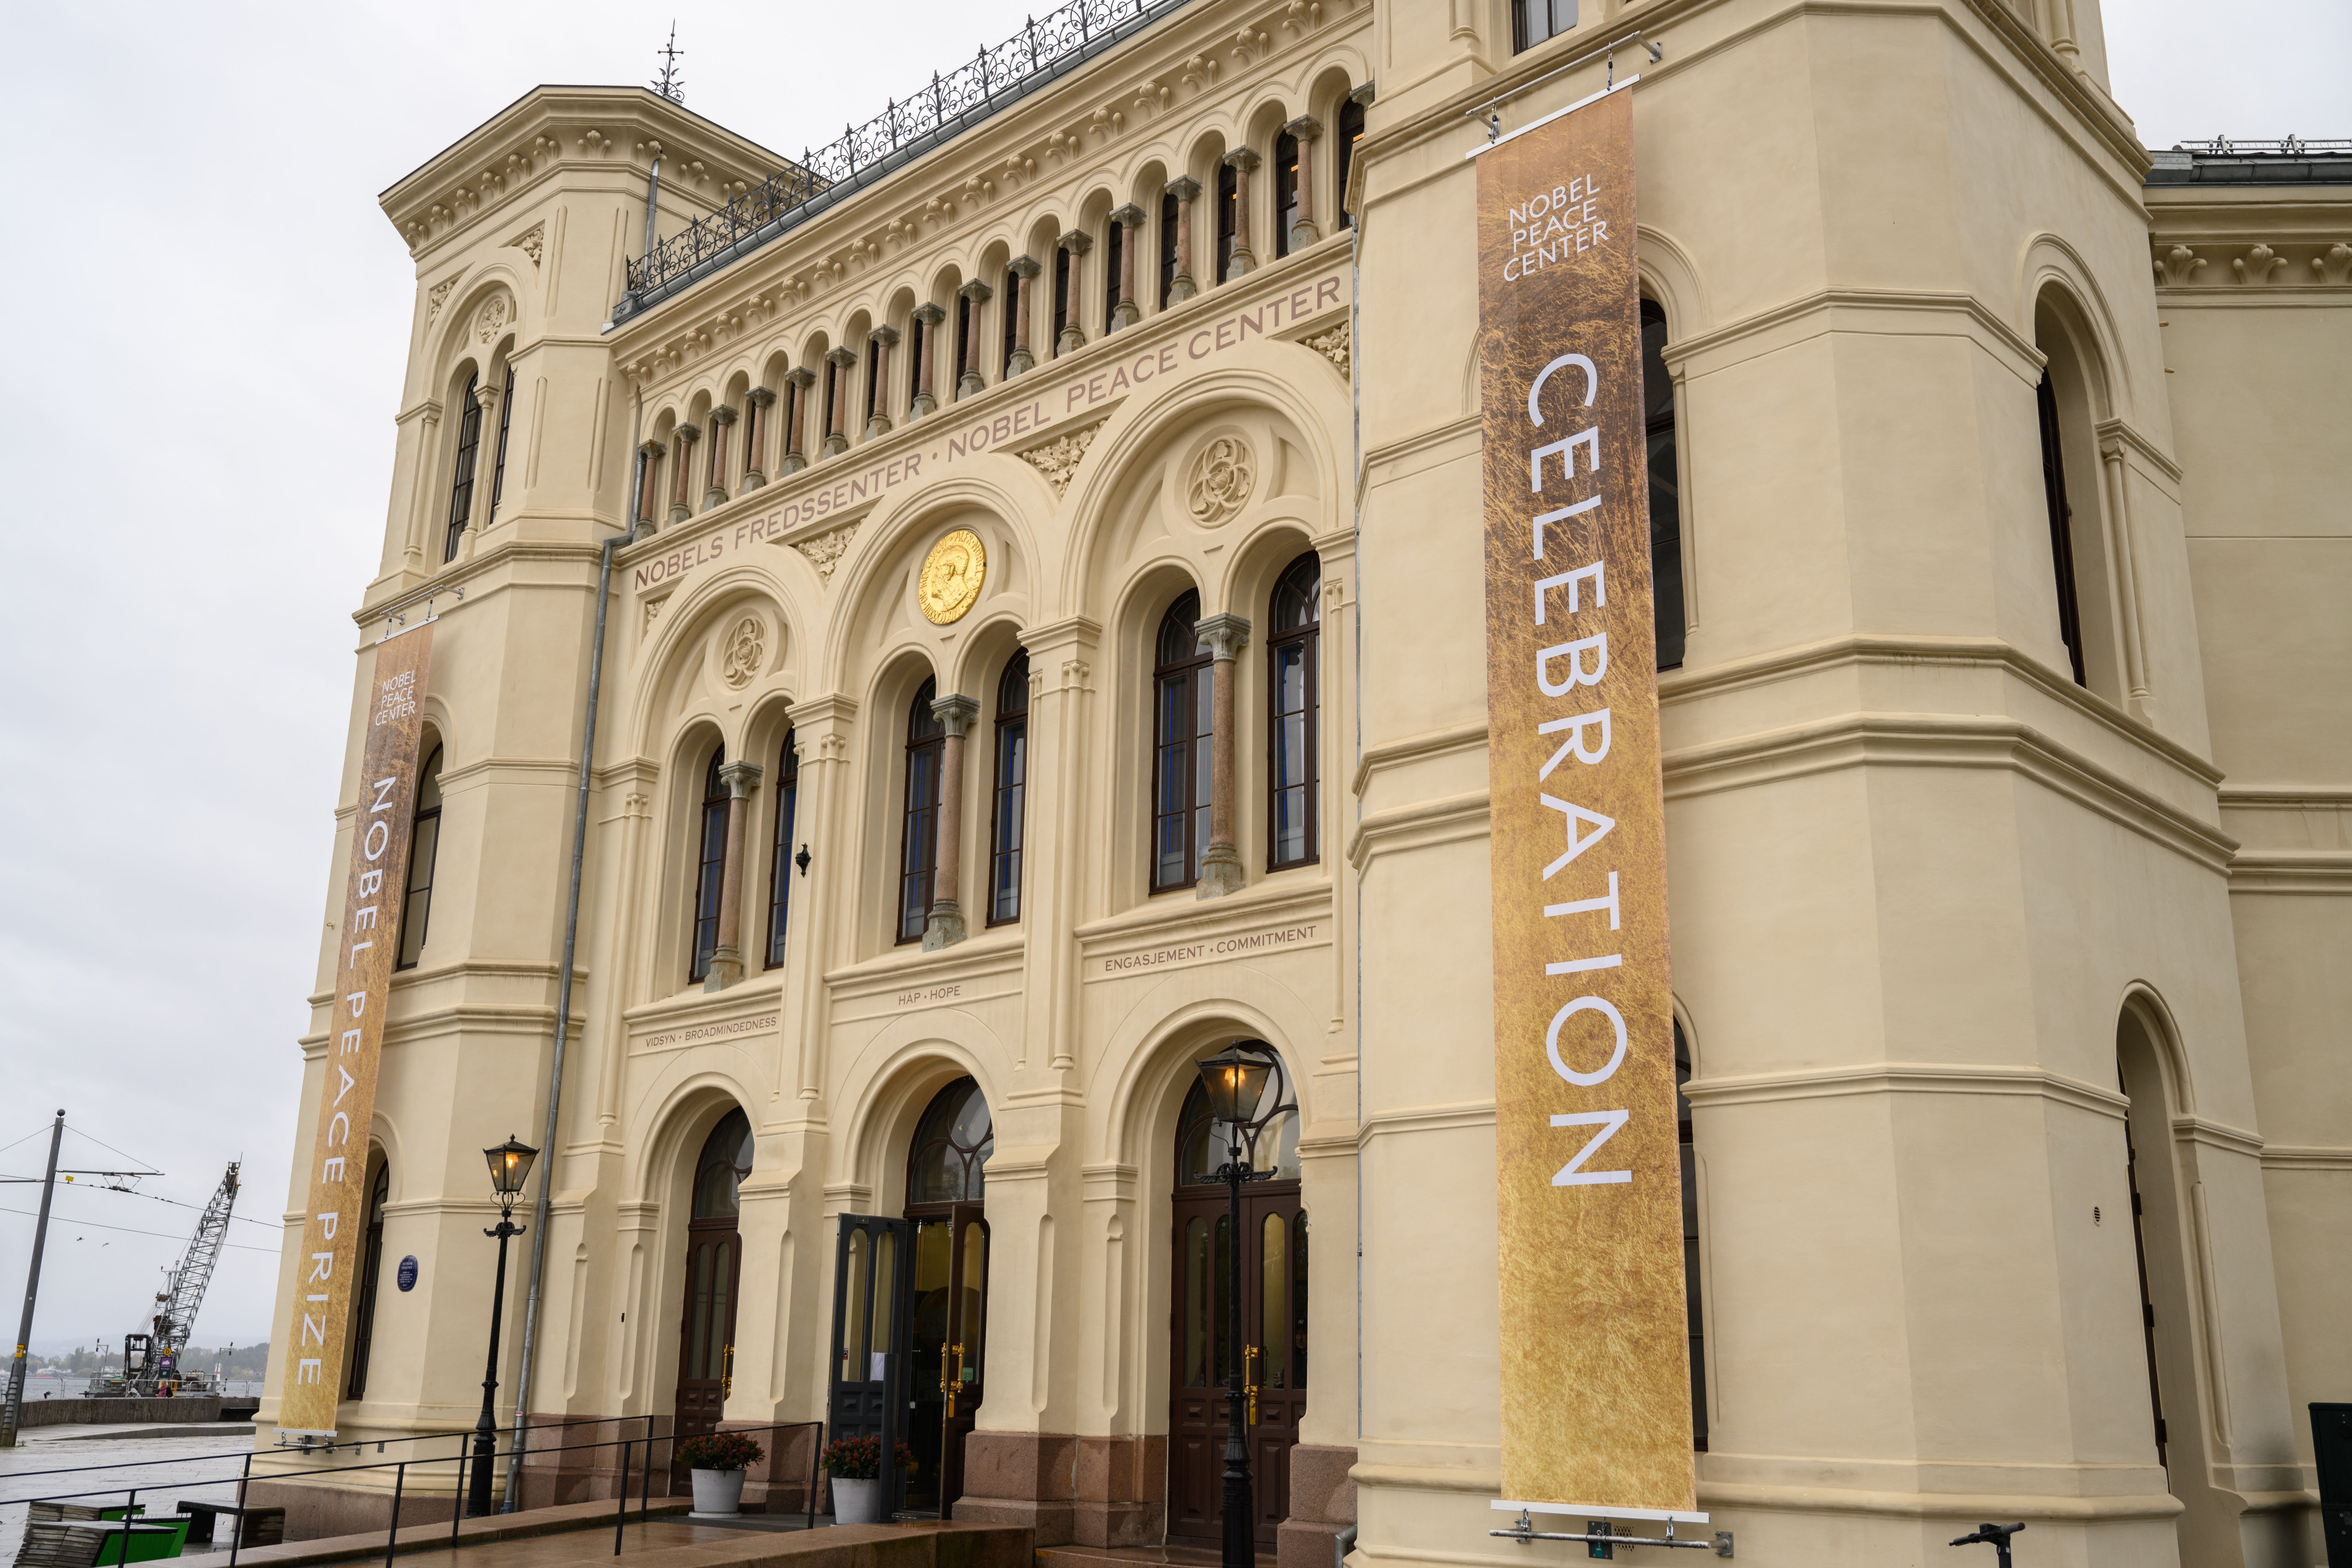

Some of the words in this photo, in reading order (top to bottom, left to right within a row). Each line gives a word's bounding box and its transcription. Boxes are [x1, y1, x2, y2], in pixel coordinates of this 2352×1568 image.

[1510, 174, 1600, 229] NOBEL
[1513, 198, 1597, 253] PEACE
[1503, 220, 1609, 282] CENTER
[635, 536, 723, 591] NOBELS
[735, 453, 921, 550] FREDSSENTER
[947, 401, 1051, 463] NOBEL
[1067, 343, 1178, 413] PEACE
[1188, 276, 1340, 360] CENTER
[381, 685, 414, 709] PEACE
[382, 670, 416, 694] NOBEL
[376, 701, 416, 726] CENTER
[1528, 353, 1632, 1186] CELEBRATION
[350, 776, 396, 969] NOBEL
[1105, 944, 1205, 972] ENGASJEMENT
[1216, 925, 1317, 954] COMMITMENT
[898, 991, 921, 1005] HÅP
[930, 985, 961, 1000] HOPE
[646, 1034, 676, 1047] VIDSYN
[685, 1017, 777, 1040] BROADMINDEDNESS
[322, 991, 366, 1184] PEACE
[298, 1212, 338, 1385] PRIZE
